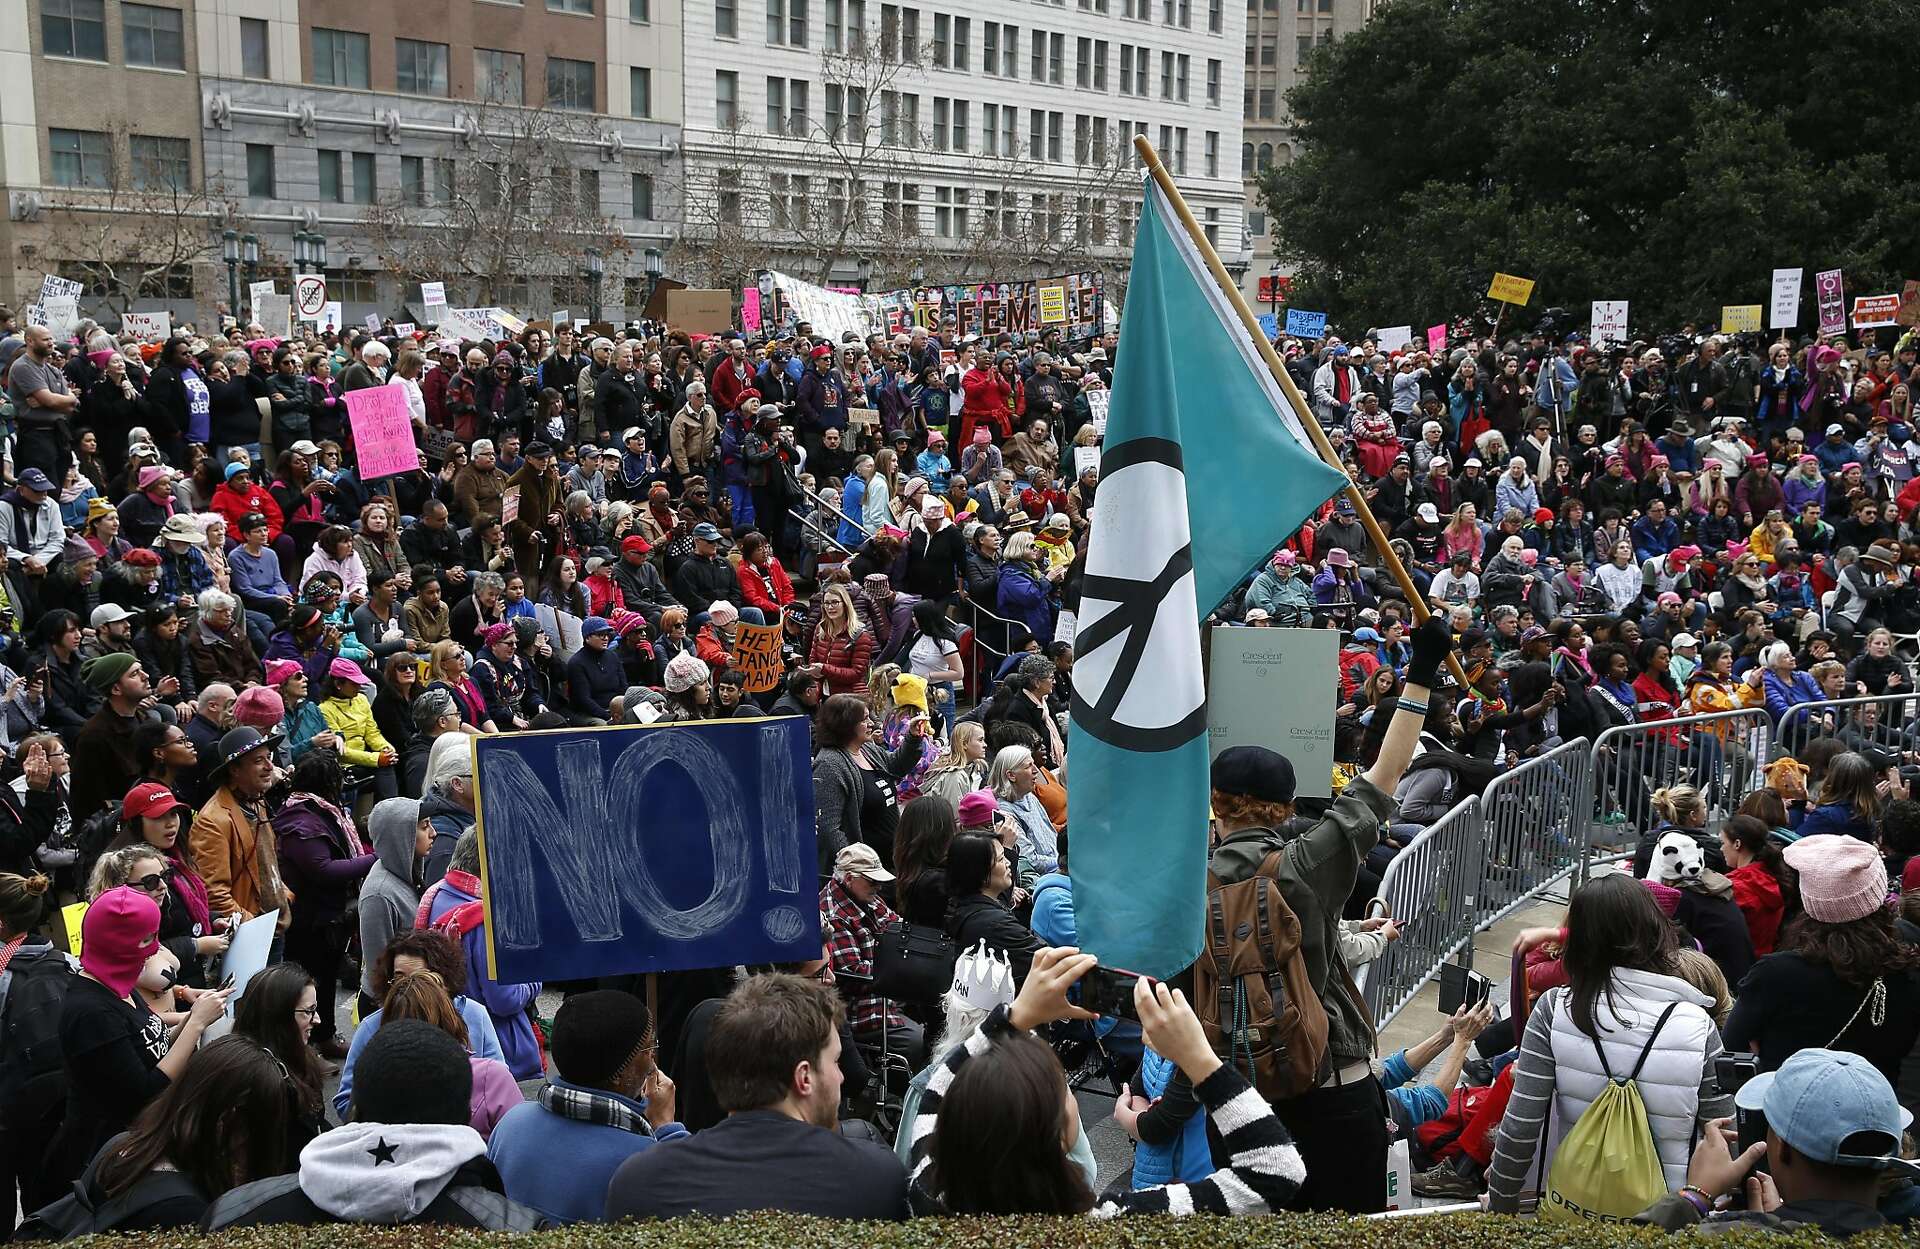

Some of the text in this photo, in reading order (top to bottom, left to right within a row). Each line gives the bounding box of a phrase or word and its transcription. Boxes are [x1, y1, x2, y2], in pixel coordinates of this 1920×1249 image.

[918, 307, 940, 333] IS
[1289, 310, 1324, 321] DISSENT
[1288, 323, 1324, 337] PATRIOTIC
[1598, 323, 1617, 331] WITH
[1242, 652, 1282, 660] Crescent
[1290, 726, 1330, 735] Crescent
[483, 724, 806, 949] NO!
[954, 978, 970, 998] CAN
